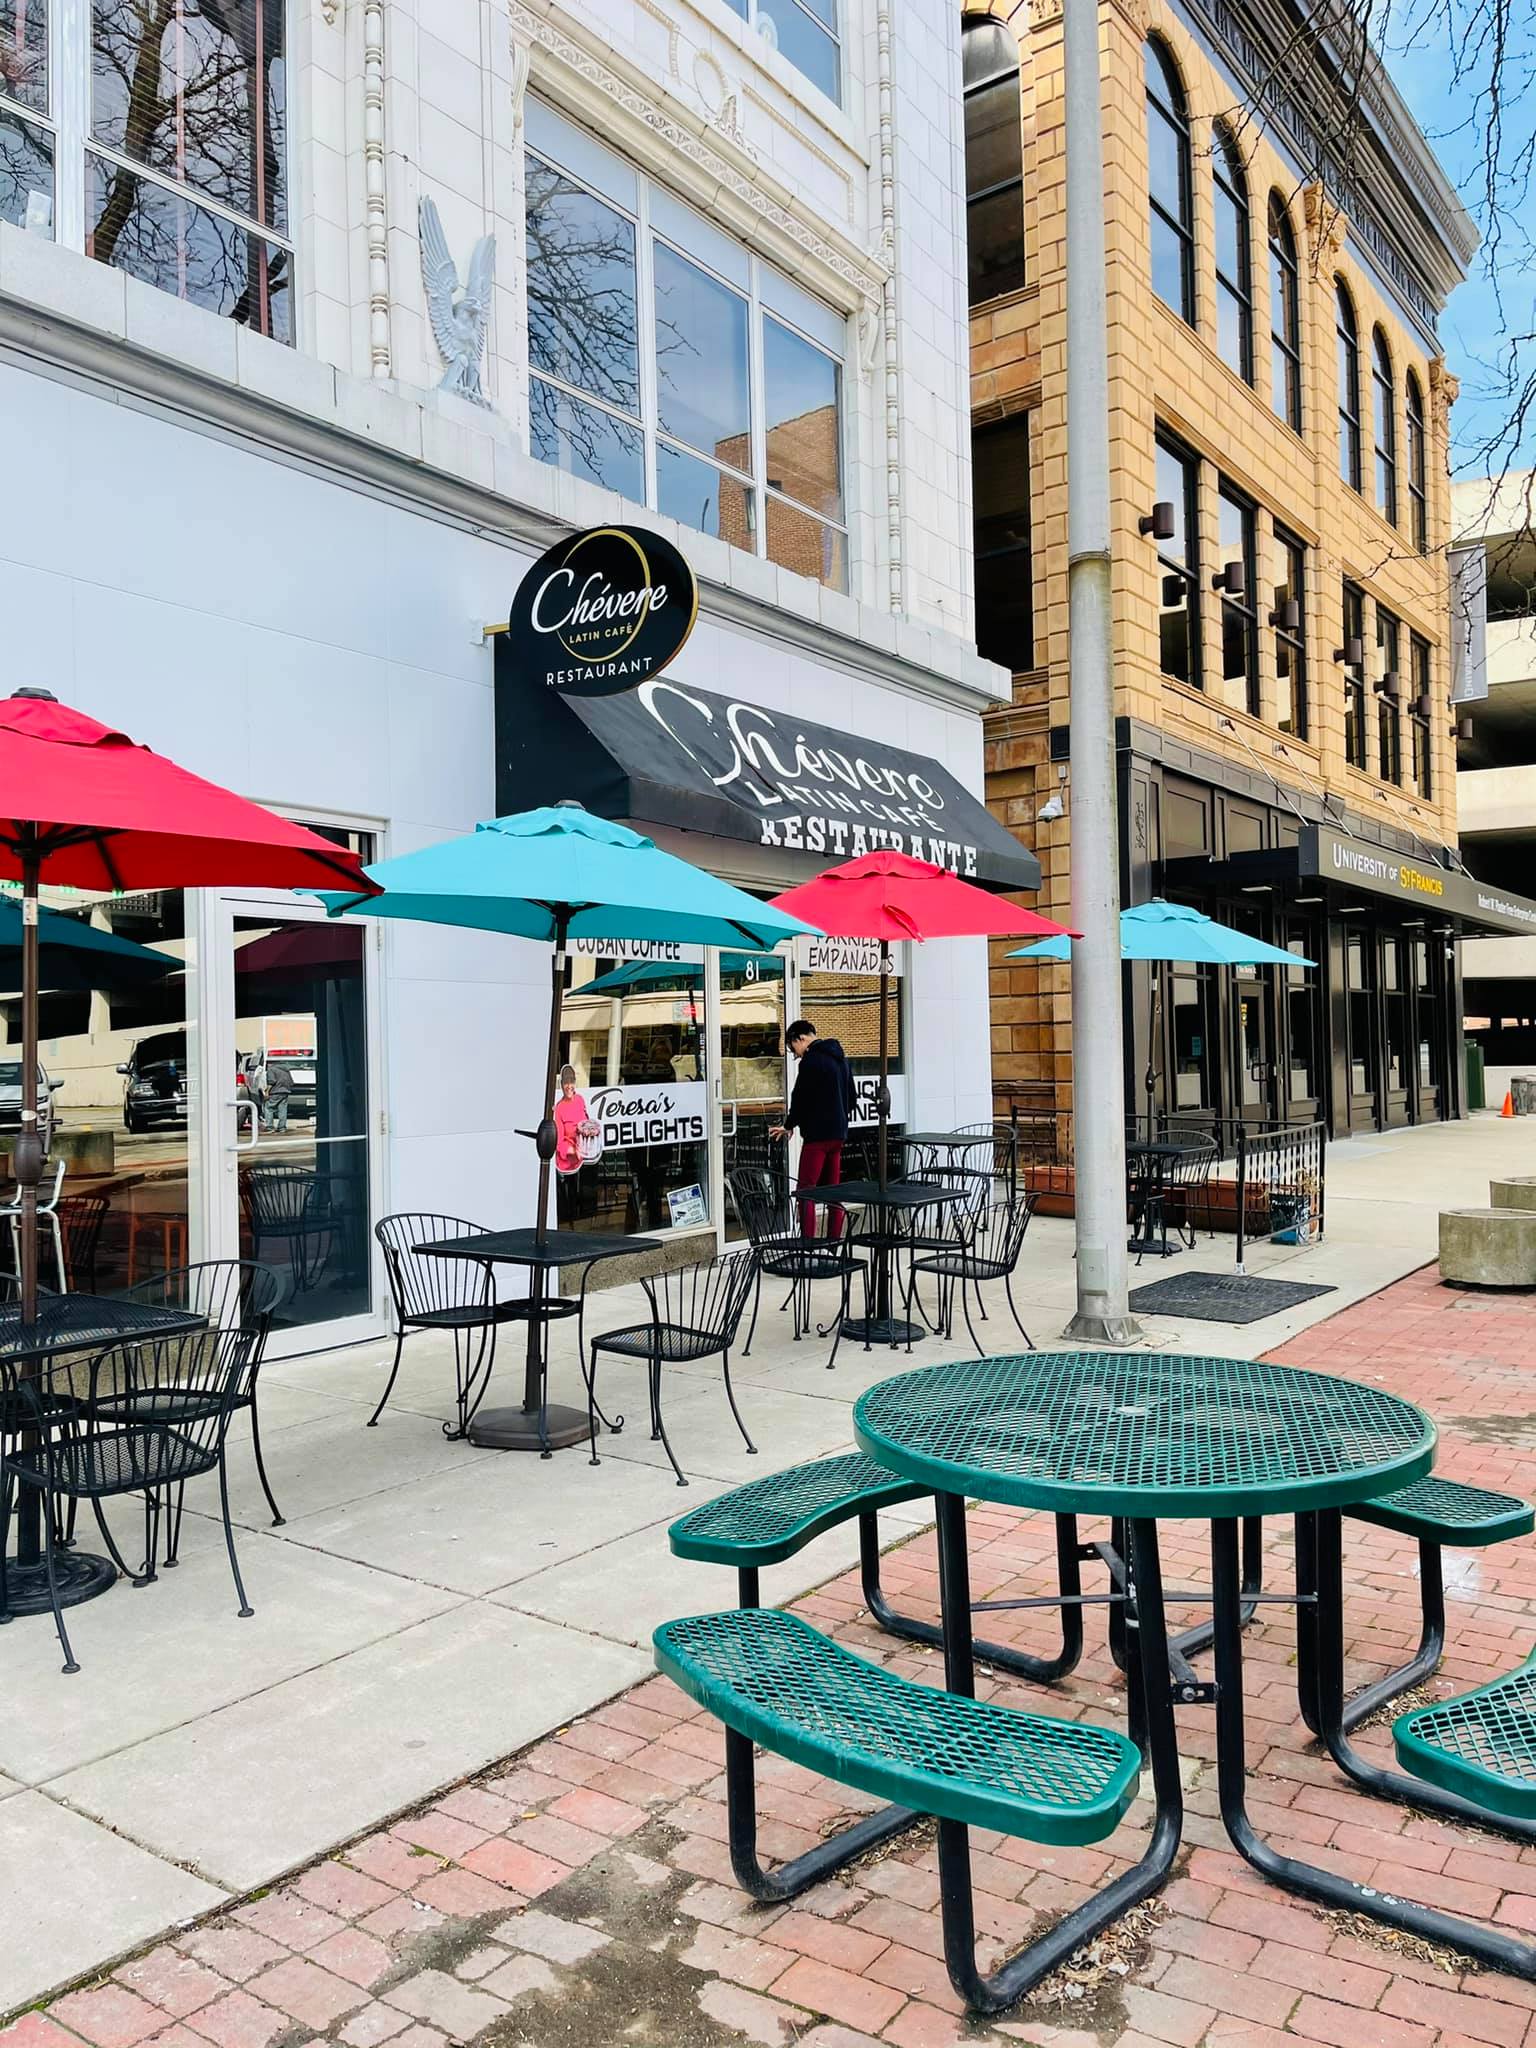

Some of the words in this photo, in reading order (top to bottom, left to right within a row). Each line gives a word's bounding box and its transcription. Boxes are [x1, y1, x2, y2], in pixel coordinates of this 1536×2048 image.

[531, 568, 668, 633] Chévere
[569, 630, 601, 644] LATIN
[605, 622, 633, 638] CAFÉ
[546, 657, 653, 685] RESTAURANT
[638, 681, 944, 810] Chévere
[744, 780, 862, 815] LATIN
[860, 800, 946, 833] CAFÉ
[760, 815, 978, 878] RESTAURANTE
[1333, 843, 1388, 880] UNIVERSITY
[1389, 866, 1399, 881] OF
[577, 938, 626, 956] CUBAN
[632, 939, 681, 961] COFFEE
[808, 946, 895, 974] EMPANADS
[745, 961, 760, 981] 81
[590, 1088, 675, 1121] Teresa's
[603, 1116, 704, 1147] DELIGHTS
